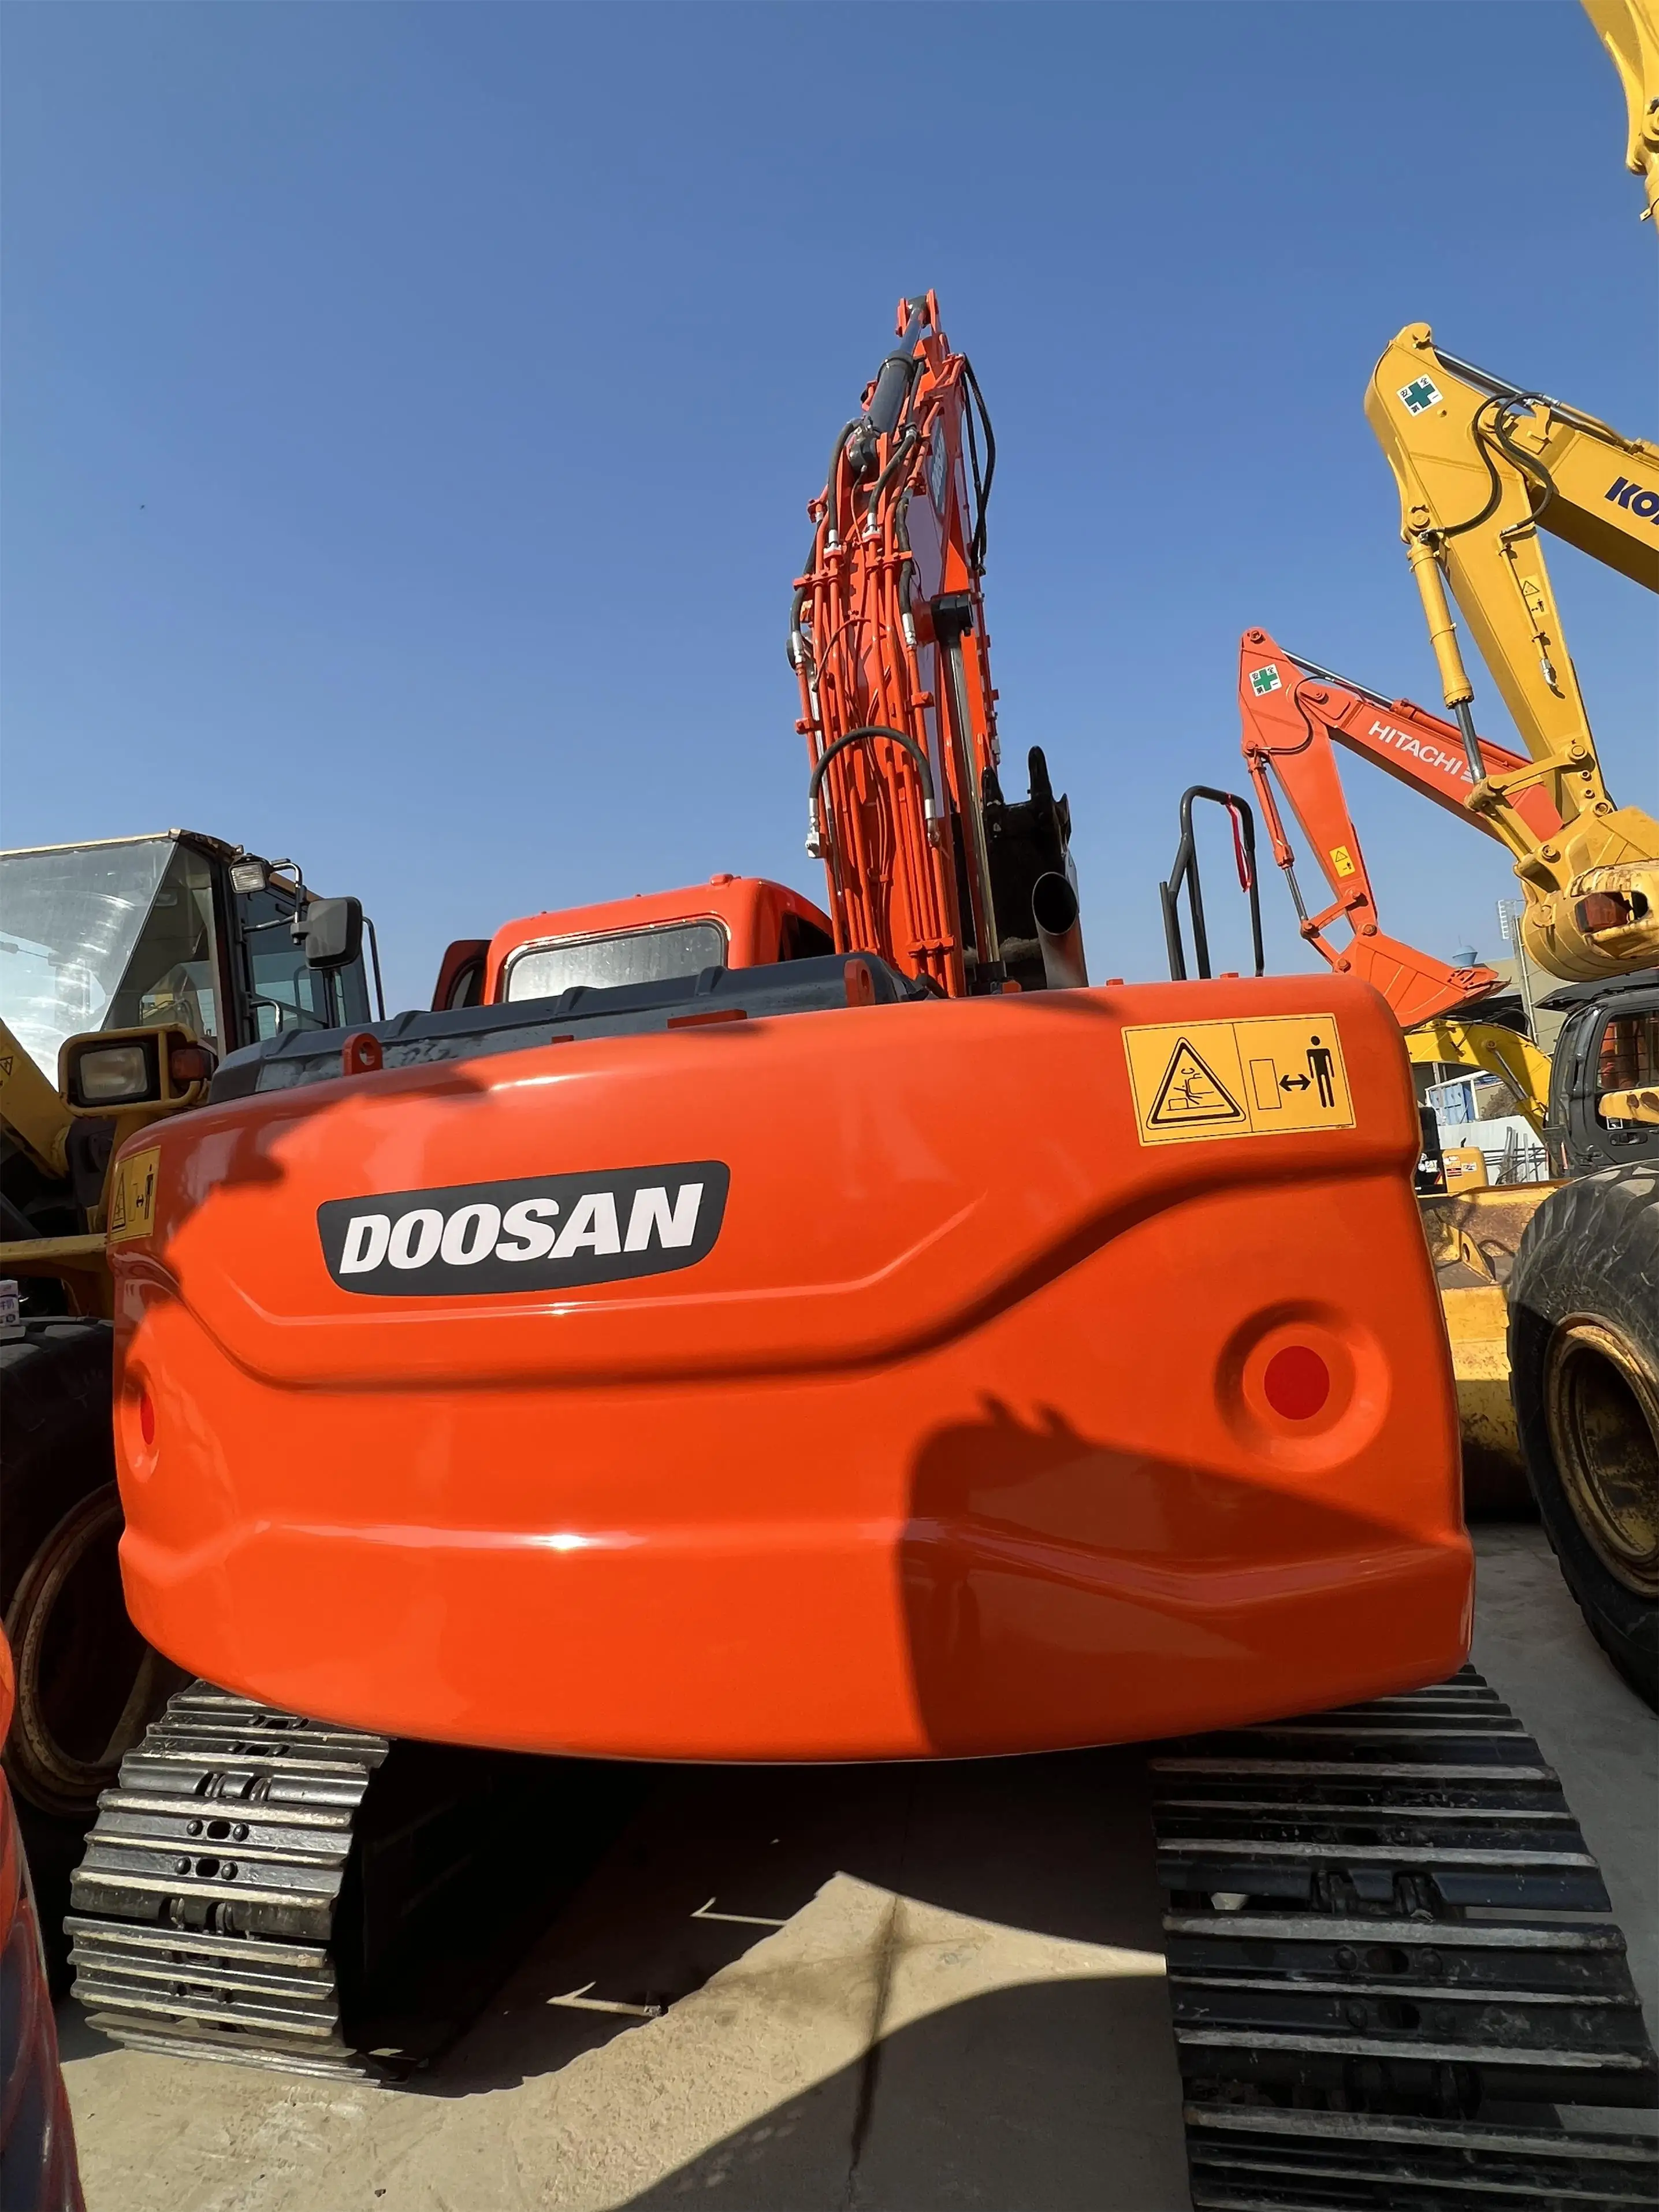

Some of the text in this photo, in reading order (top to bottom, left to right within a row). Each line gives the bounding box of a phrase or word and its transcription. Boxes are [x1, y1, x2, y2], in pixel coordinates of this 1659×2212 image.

[1604, 476, 1659, 526] KO
[1368, 720, 1463, 775] HITACHI
[339, 1183, 704, 1274] DOOSAN
